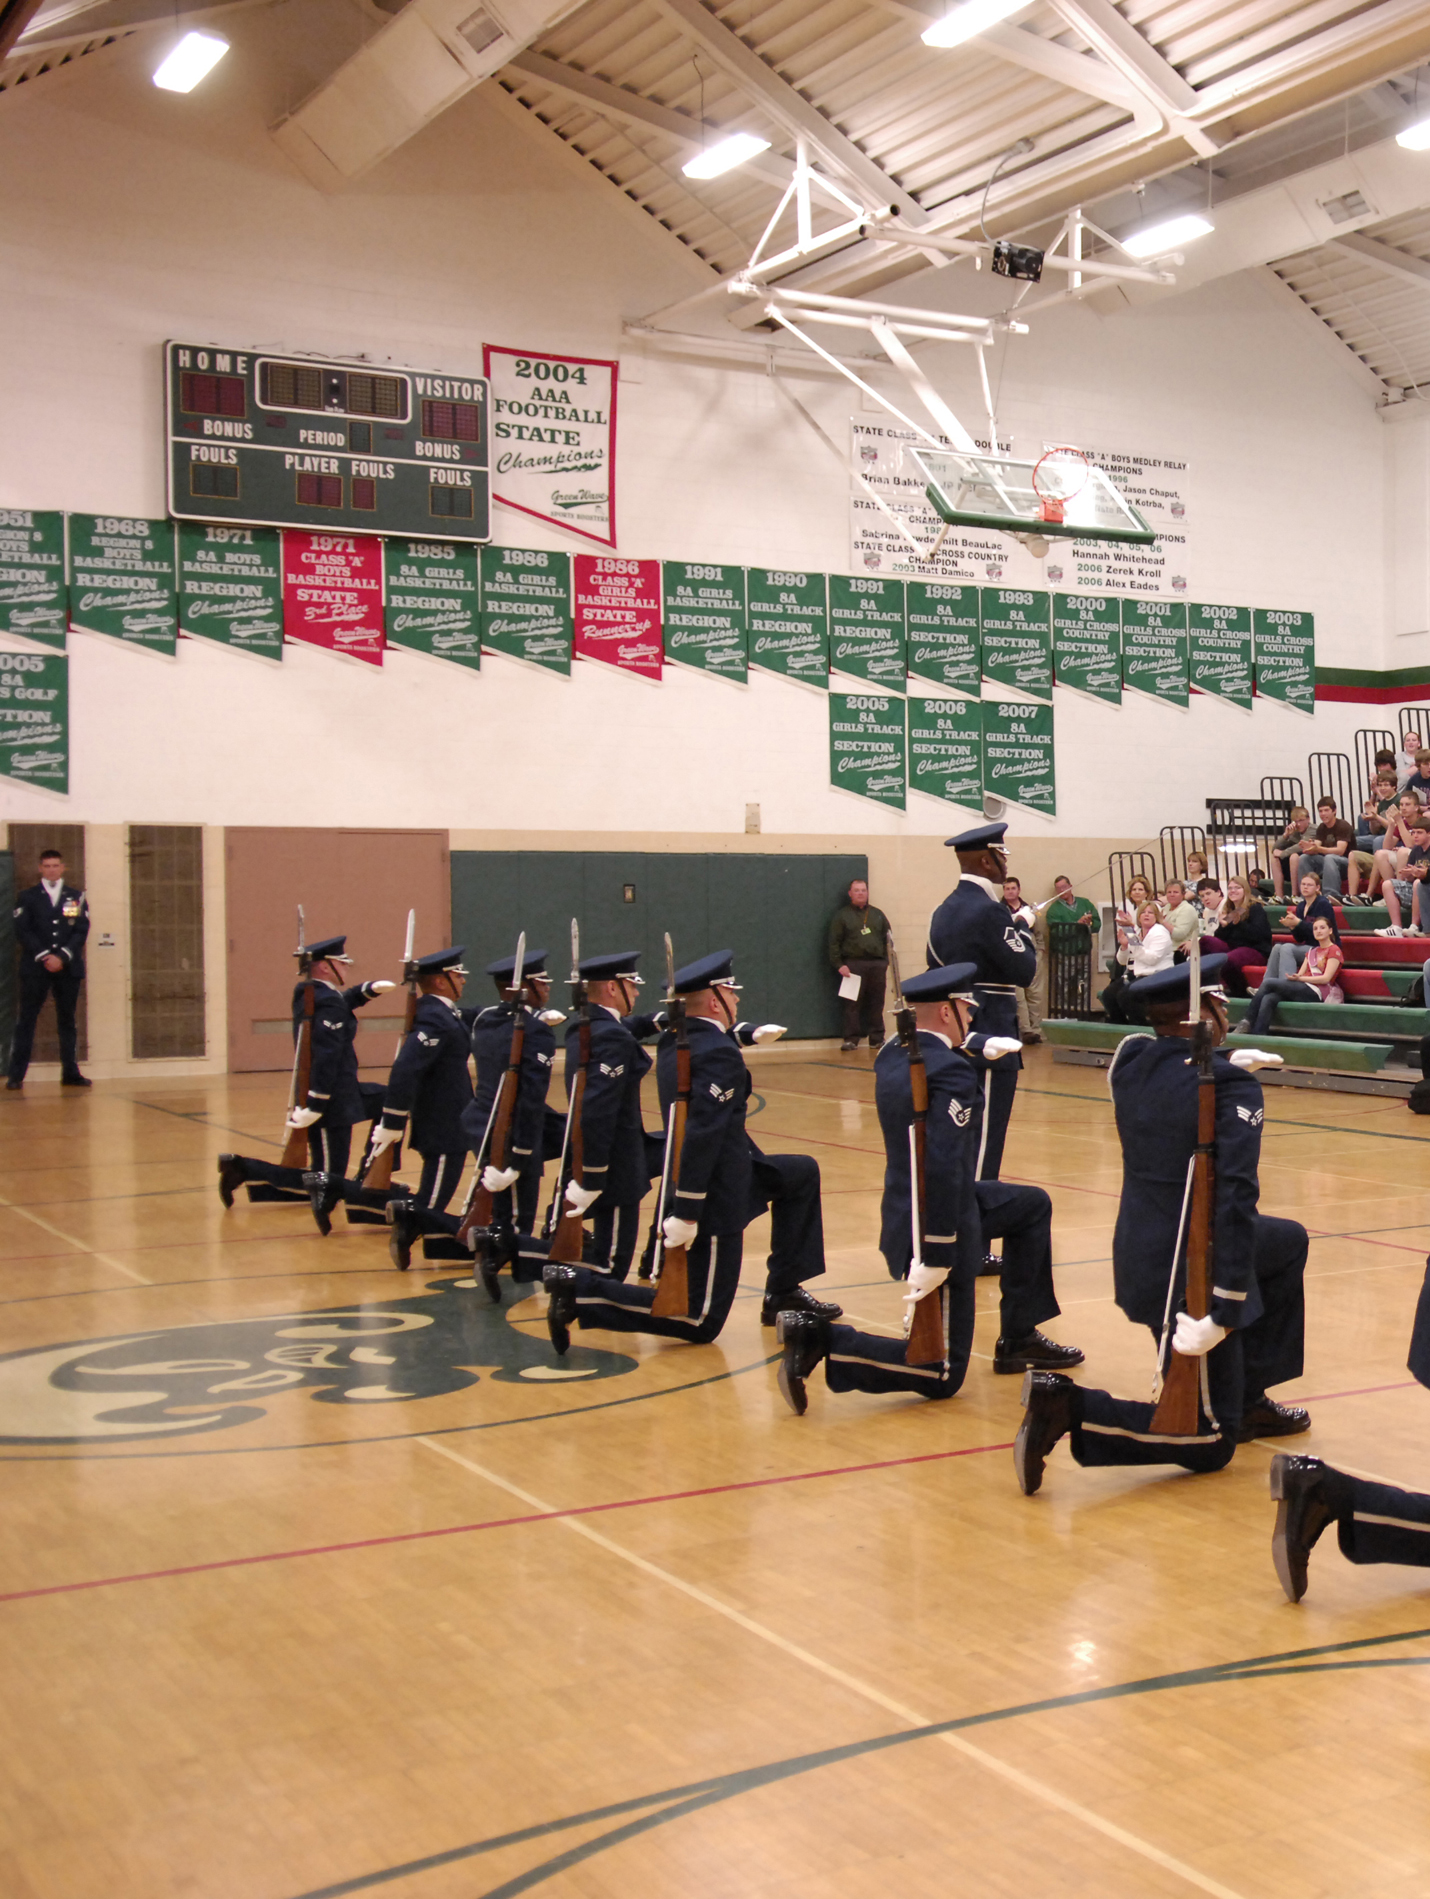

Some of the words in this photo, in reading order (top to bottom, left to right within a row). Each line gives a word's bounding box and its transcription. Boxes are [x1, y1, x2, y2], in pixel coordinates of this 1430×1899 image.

[179, 350, 248, 374] HOME
[515, 359, 587, 385] 2004
[415, 377, 484, 401] VISITOR
[530, 387, 572, 404] AAA
[495, 398, 607, 425] FOOTBALL
[203, 419, 253, 439] BONUS
[495, 422, 581, 446] STATE
[853, 425, 884, 437] STATE
[299, 430, 345, 447] PERIOD
[191, 445, 238, 464] FOULS
[415, 441, 461, 460] BONUS
[285, 455, 339, 474] PLAYER
[351, 460, 395, 479] FOULS
[497, 448, 606, 474] Champions
[1111, 454, 1131, 464] BOYS
[1132, 456, 1162, 468] MEDLEY
[1164, 459, 1187, 470] RELAY
[429, 468, 472, 486] FOULS
[1108, 474, 1128, 484] 1996
[1122, 485, 1147, 495] Jason
[94, 517, 149, 536] 1968
[91, 536, 141, 549] REGION
[144, 540, 154, 550] 8
[205, 527, 254, 545] 1971
[309, 535, 357, 553] 1971
[407, 543, 456, 560] 1985
[104, 547, 142, 560] BOYS
[196, 550, 217, 562] 8A
[224, 552, 261, 565] BOYS
[301, 552, 346, 565] CLASS
[502, 549, 549, 567] 1986
[853, 541, 884, 551] STATE
[886, 544, 915, 554] CLASS
[967, 551, 1009, 563] COUNTRY
[1072, 549, 1110, 561] Hannah
[1113, 552, 1165, 566] Whitehead
[73, 556, 172, 573] BASKETBALL
[595, 558, 640, 575] 1986
[908, 555, 958, 567] CHAMPION
[183, 561, 277, 578] BASKETBALL
[315, 564, 351, 577] BOYS
[399, 564, 420, 577] 8A
[425, 567, 465, 580] GIRLS
[685, 565, 723, 581] 1991
[892, 563, 916, 573] 2003
[917, 565, 939, 575] Matt
[941, 567, 975, 578] Damico
[1077, 563, 1103, 573] 2006
[1105, 565, 1135, 576] Zerek
[1138, 567, 1162, 578] Kroll
[75, 573, 158, 590] REGION
[287, 573, 380, 590] BASKETBALL
[389, 575, 475, 591] BASKETBALL
[495, 571, 514, 583] 8A
[518, 573, 557, 586] GIRLS
[589, 574, 629, 586] CLASS
[766, 572, 808, 588] 1990
[1077, 577, 1103, 586] 2006
[1105, 578, 1126, 588] Alex
[1130, 580, 1160, 591] Eades
[184, 581, 263, 597] REGION
[484, 582, 567, 598] BASKETBALL
[599, 586, 636, 598] GIRLS
[698, 587, 733, 599] GIRLS
[849, 579, 885, 594] 1991
[925, 584, 962, 601] 1992
[79, 589, 170, 611] Champions
[296, 588, 358, 605] STATE
[390, 594, 462, 611] REGION
[577, 594, 658, 610] BASKETBALL
[666, 596, 743, 610] BASKETBALL
[998, 590, 1034, 605] 1993
[1066, 596, 1106, 611] 2000
[187, 597, 275, 619] Champions
[303, 606, 328, 620] 3rd
[330, 603, 370, 618] Place
[486, 600, 555, 617] REGION
[582, 608, 637, 623] STATE
[750, 602, 783, 614] GIRLS
[785, 605, 824, 616] TRACK
[832, 608, 864, 620] GIRLS
[865, 611, 902, 622] TRACK
[1137, 602, 1171, 616] 2001
[1201, 606, 1238, 620] 2002
[668, 613, 731, 628] REGION
[909, 614, 941, 625] GIRLS
[942, 616, 977, 627] TRACK
[983, 619, 1013, 630] GIRLS
[1015, 621, 1049, 632] TRACK
[1054, 618, 1084, 629] GIRLS
[1086, 620, 1119, 632] CROSS
[1267, 611, 1302, 625] 2003
[752, 619, 813, 634] REGION
[834, 625, 892, 640] REGION
[1063, 628, 1110, 640] COUNTRY
[1124, 625, 1153, 636] GIRLS
[1155, 627, 1186, 637] CROSS
[1190, 628, 1218, 638] GIRLS
[1220, 630, 1251, 640] CROSS
[911, 631, 969, 645] SECTION
[984, 636, 1040, 649] SECTION
[1132, 635, 1177, 645] COUNTRY
[1198, 637, 1242, 648] COUNTRY
[1255, 634, 1282, 644] GIRLS
[1284, 636, 1313, 646] CROSS
[1056, 641, 1108, 654] SECTION
[1125, 646, 1176, 658] SECTION
[1263, 643, 1305, 654] COUNTRY
[1193, 651, 1241, 663] SECTION
[1257, 655, 1303, 667] SECTION
[14, 688, 58, 701] GOLF
[846, 696, 890, 712] 2005
[924, 700, 967, 715] 2006
[998, 705, 1038, 719] 2007
[832, 722, 864, 733] GIRLS
[866, 724, 903, 735] TRACK
[912, 729, 942, 740] GIRLS
[944, 731, 979, 741] TRACK
[986, 733, 1016, 743] GIRLS
[1018, 734, 1051, 744] TRACK
[834, 740, 895, 753] SECTION
[913, 743, 971, 756] SECTION
[988, 747, 1043, 759] SECTION
